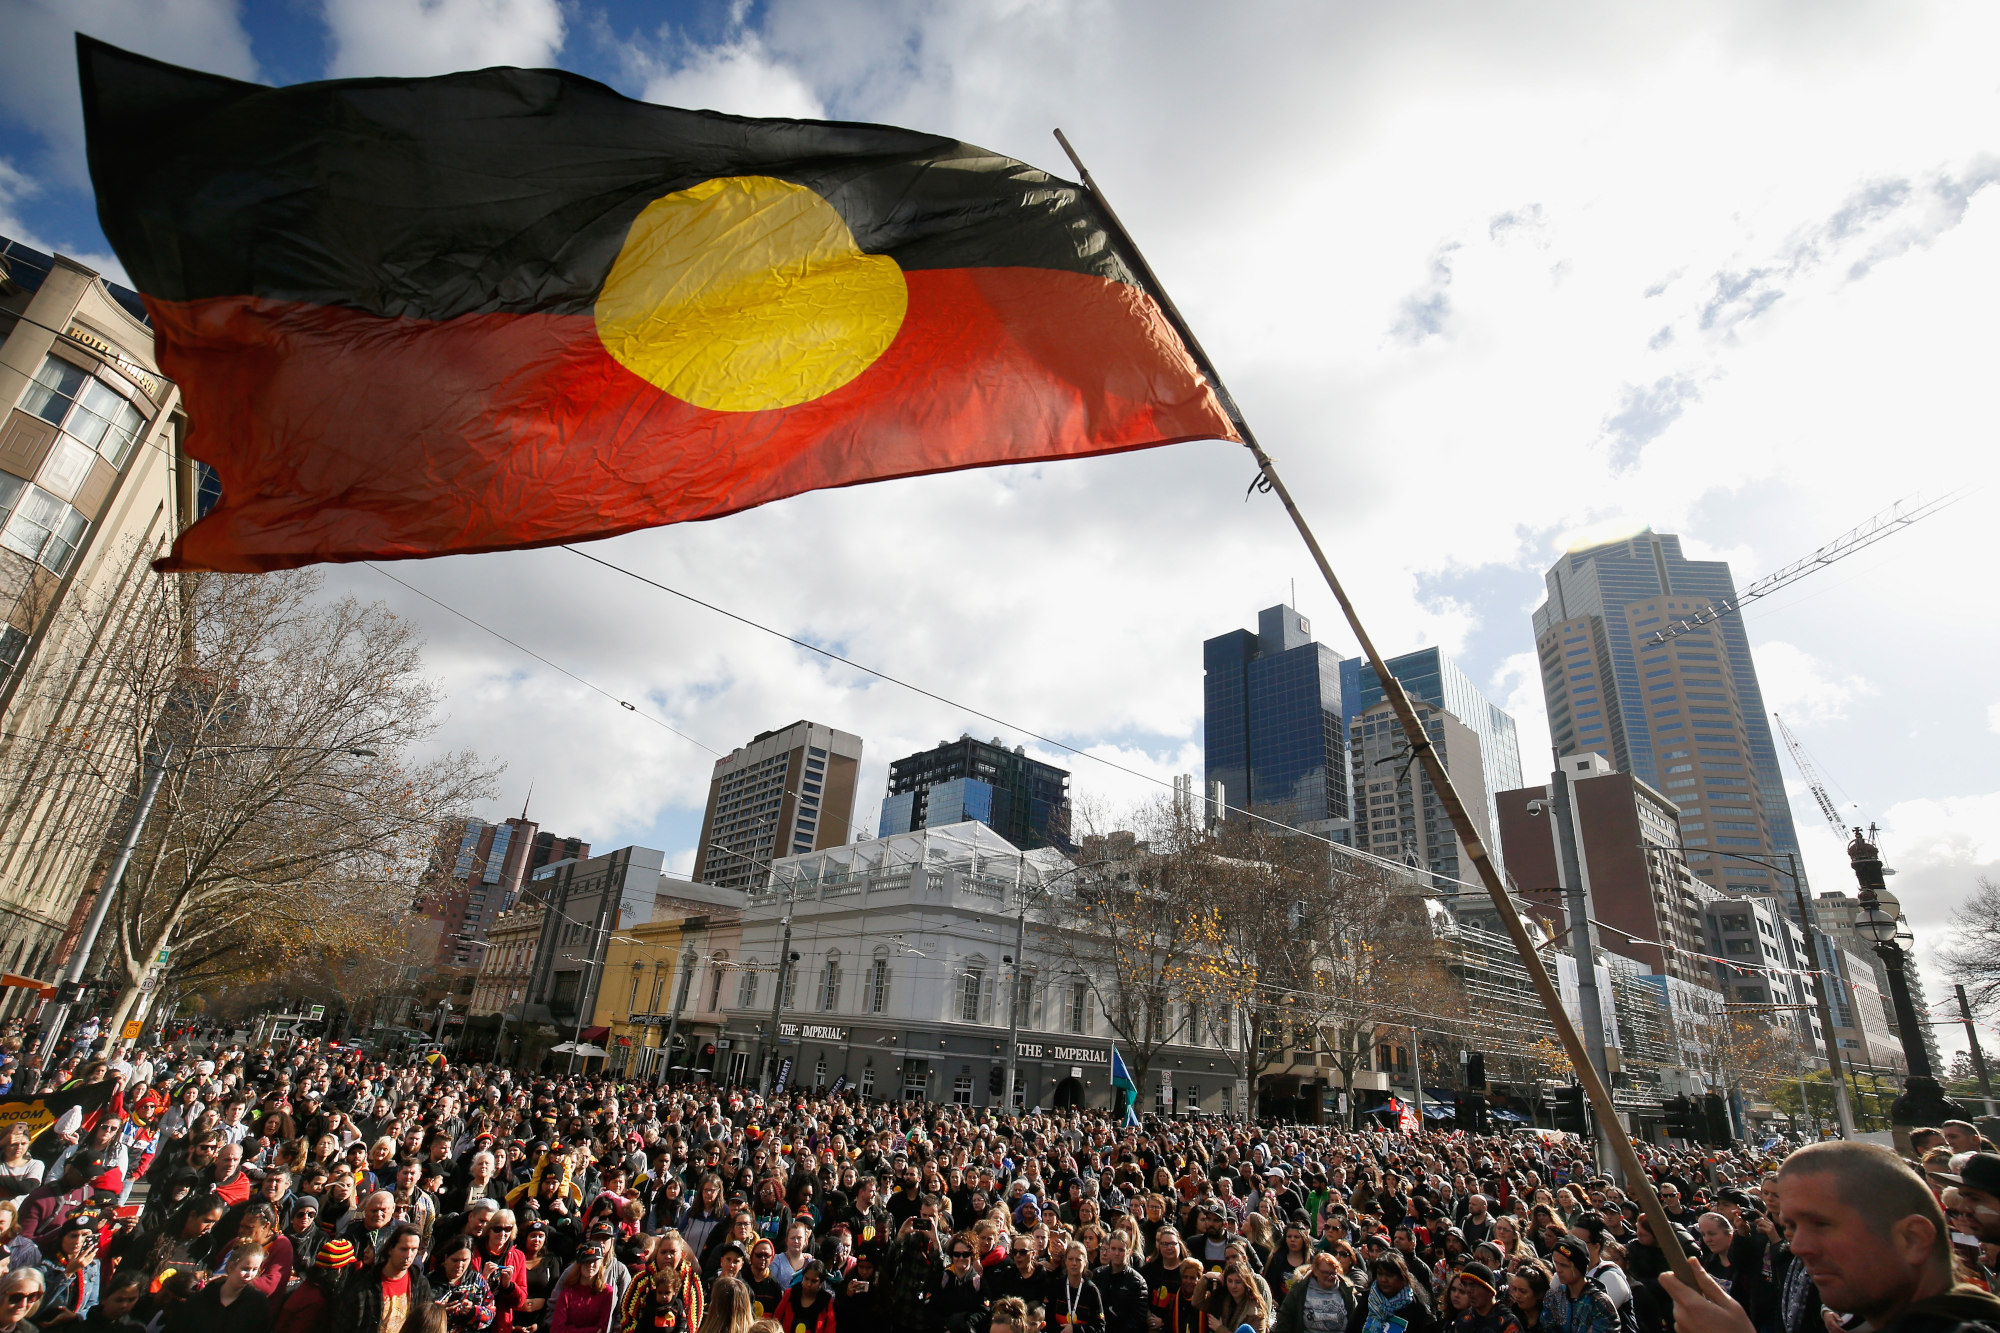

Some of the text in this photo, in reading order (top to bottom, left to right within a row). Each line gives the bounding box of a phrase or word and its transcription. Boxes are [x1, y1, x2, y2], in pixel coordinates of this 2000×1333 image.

[70, 327, 112, 358] HOTEL
[780, 1023, 842, 1040] THE IMPERIAL
[1016, 1043, 1108, 1063] THE IMPERIAL
